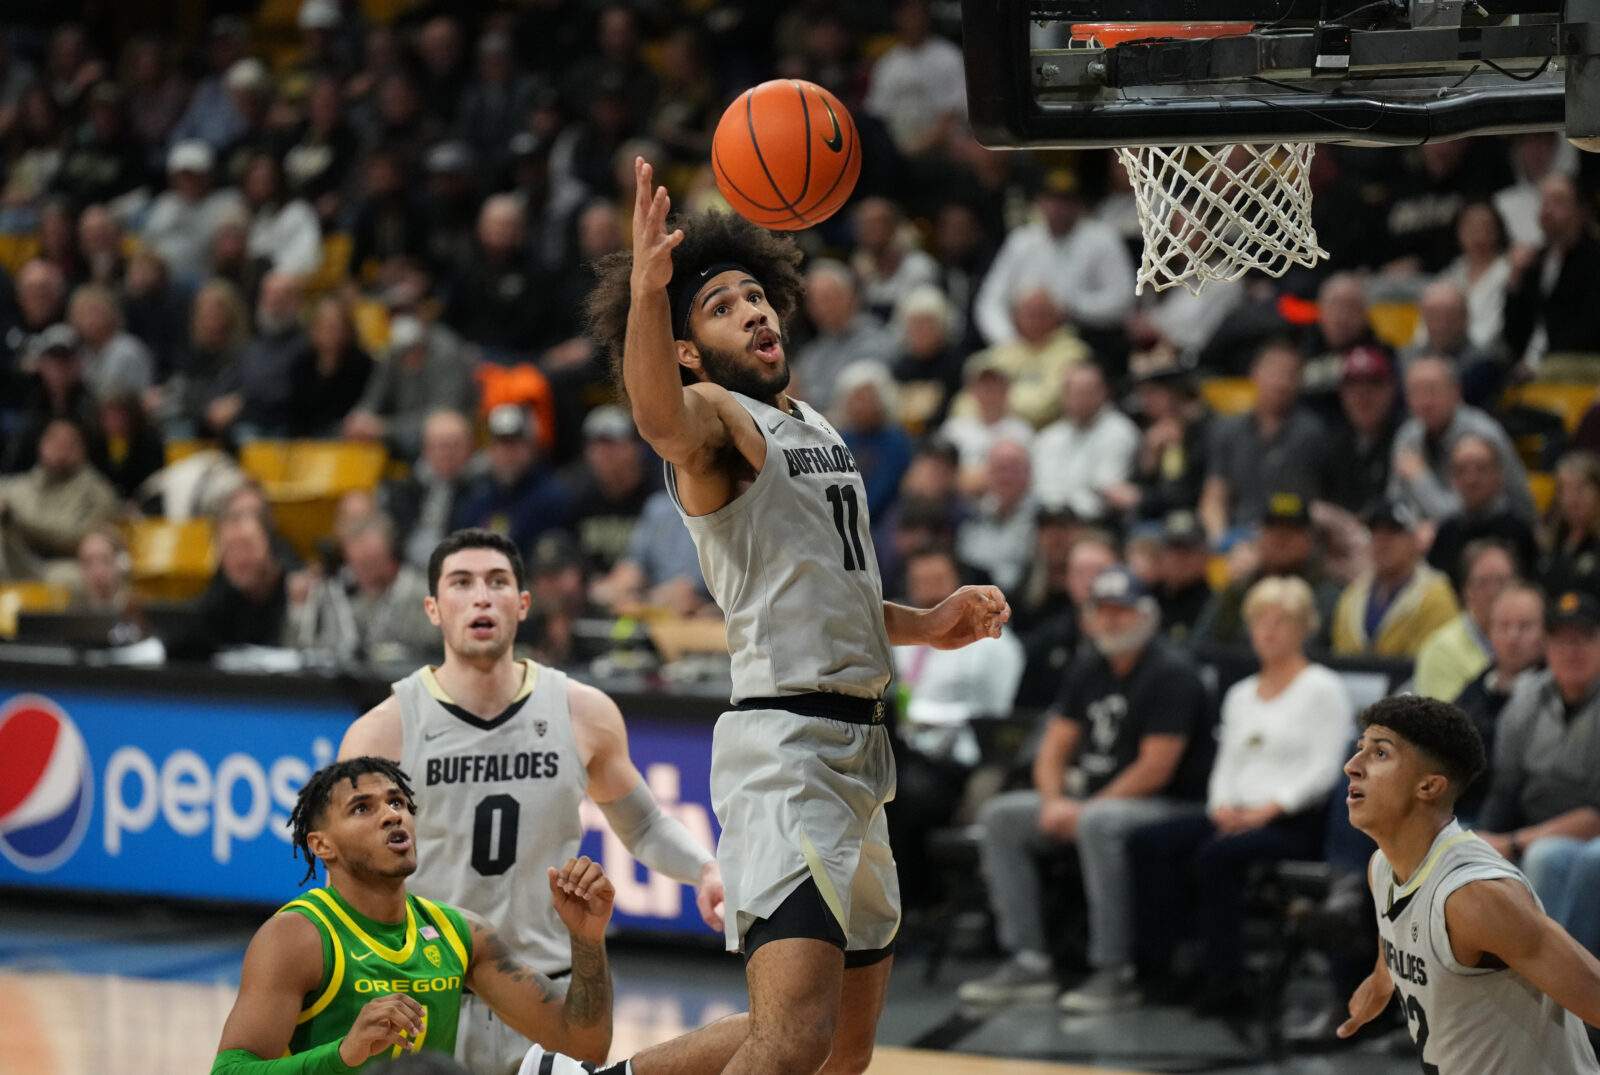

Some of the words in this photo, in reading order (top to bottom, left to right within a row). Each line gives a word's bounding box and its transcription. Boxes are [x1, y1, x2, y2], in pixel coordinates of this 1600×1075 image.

[825, 484, 866, 571] 11
[426, 752, 559, 786] BUFFALOES
[471, 793, 520, 877] 0
[354, 976, 460, 993] OREGON
[1394, 983, 1439, 1075] 2
